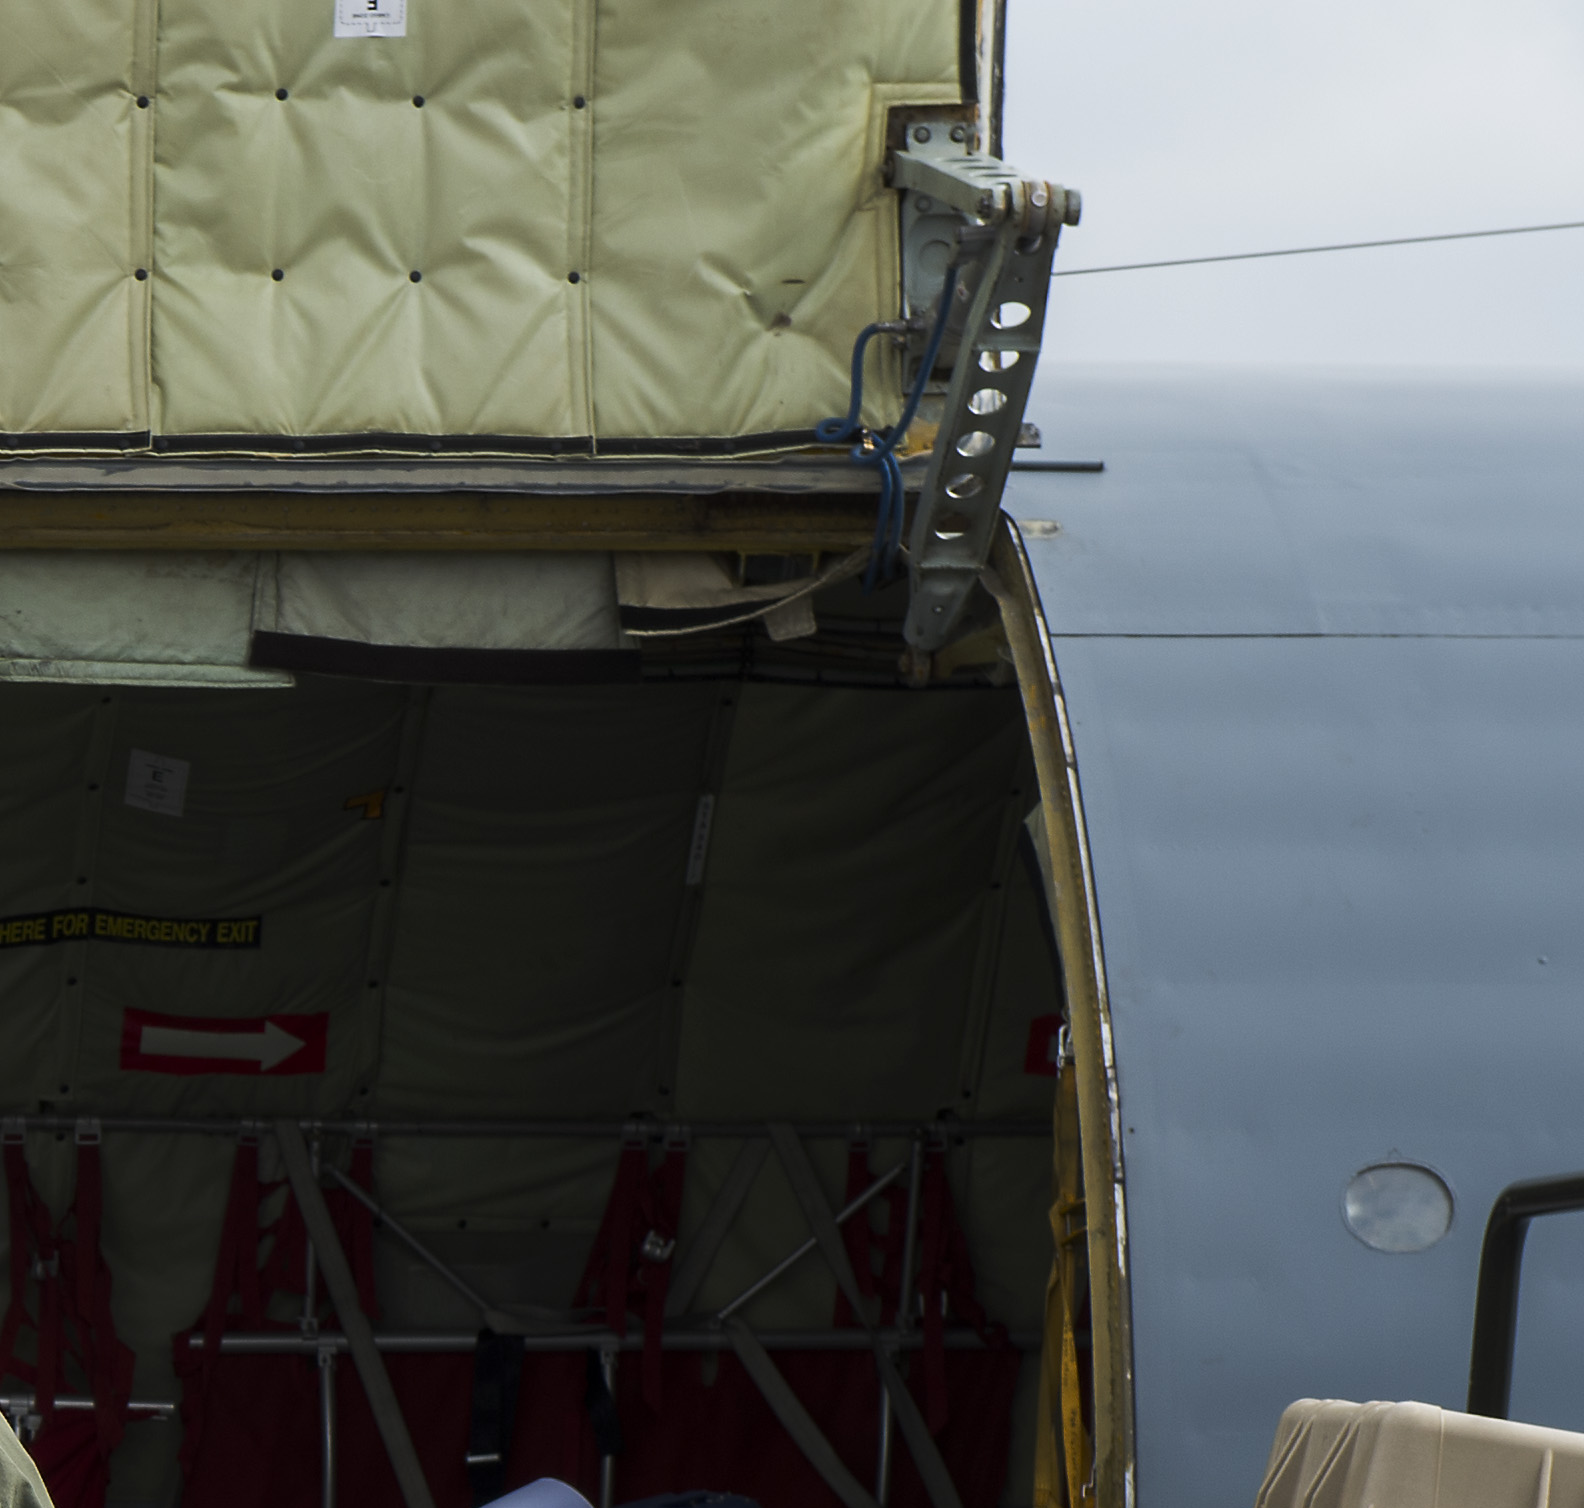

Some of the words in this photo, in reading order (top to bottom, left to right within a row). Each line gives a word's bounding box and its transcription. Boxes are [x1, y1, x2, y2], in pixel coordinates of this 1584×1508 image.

[53, 913, 89, 938] FOR
[95, 914, 211, 943] EMERGENCY
[216, 920, 257, 943] EXIT
